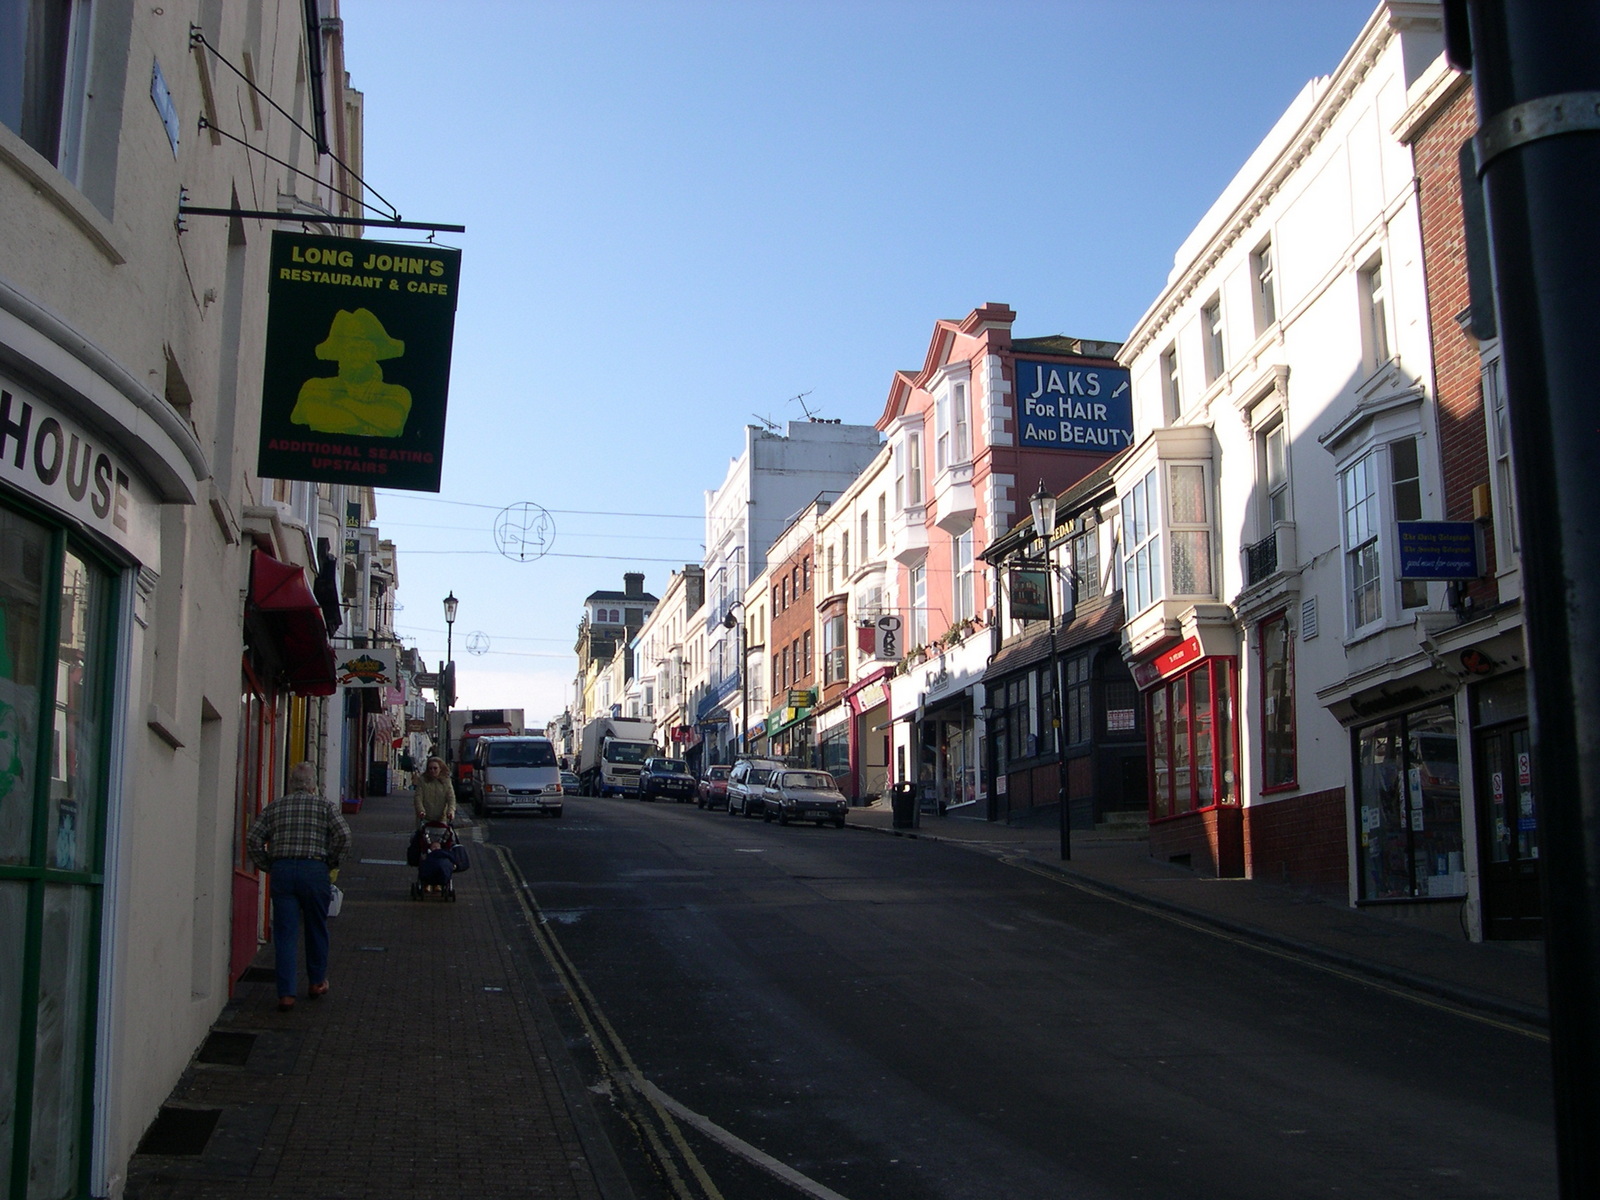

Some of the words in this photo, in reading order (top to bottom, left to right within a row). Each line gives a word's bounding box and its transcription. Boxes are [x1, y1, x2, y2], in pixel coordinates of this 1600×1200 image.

[292, 246, 353, 267] LONG
[363, 254, 444, 276] JOHN'S
[280, 268, 383, 289] RESTAURANT
[389, 278, 399, 291] &
[407, 281, 448, 295] CAFE
[1031, 365, 1101, 398] JAKS
[0, 390, 129, 534] HOUSE
[267, 438, 362, 458] ADDITIONAL
[368, 447, 434, 464] SEATING
[310, 456, 389, 474] UPSTAIRS
[877, 616, 901, 657] JAKS
